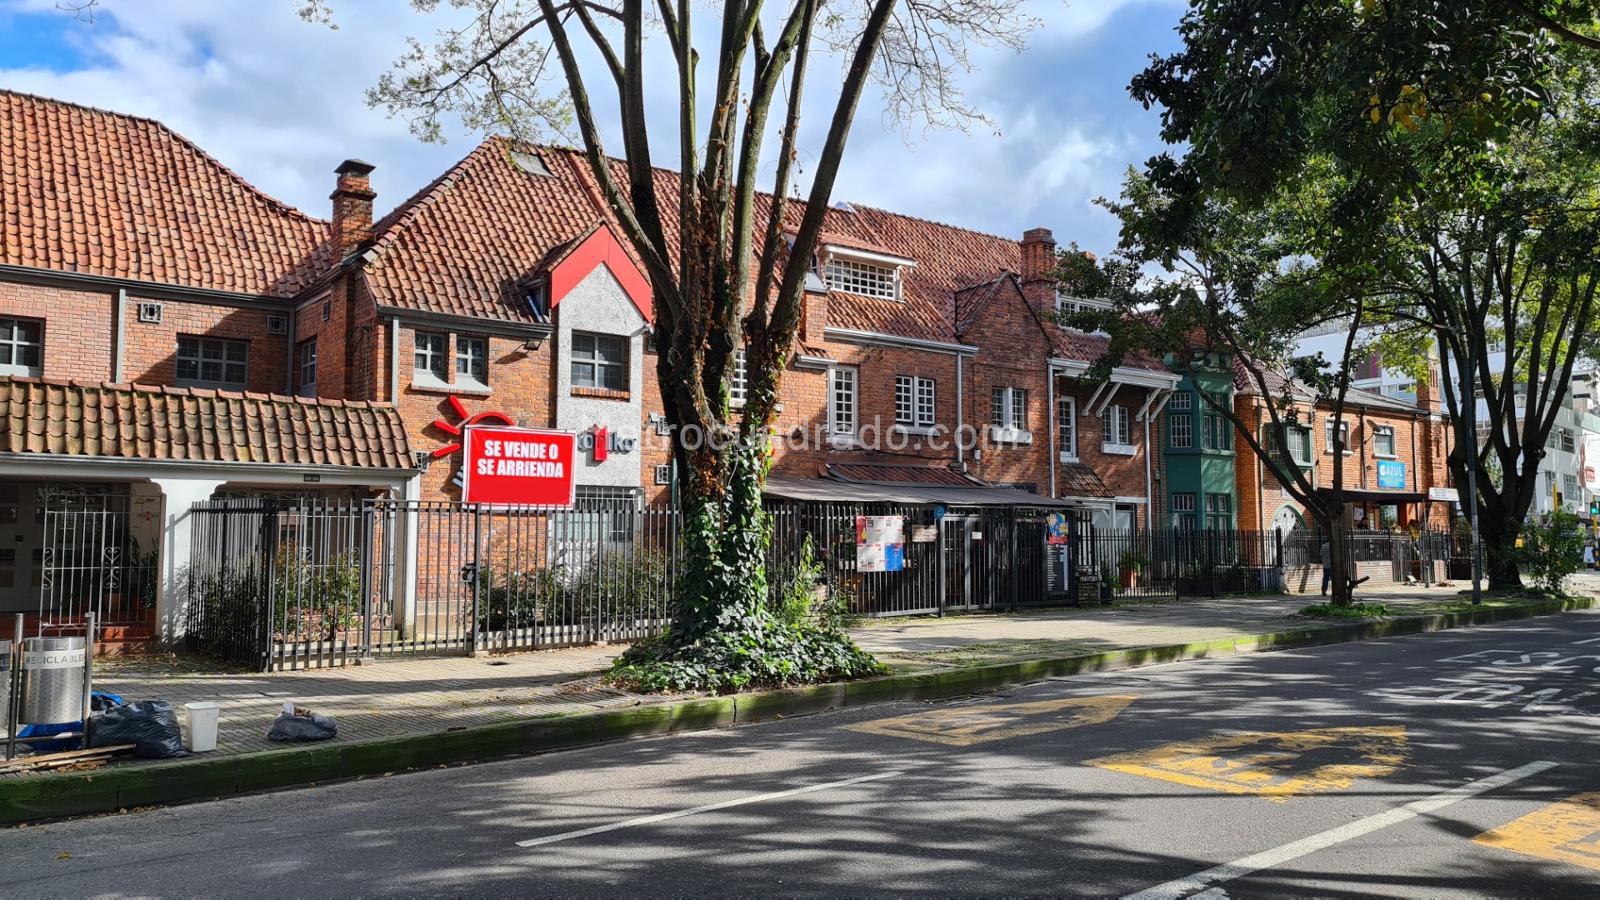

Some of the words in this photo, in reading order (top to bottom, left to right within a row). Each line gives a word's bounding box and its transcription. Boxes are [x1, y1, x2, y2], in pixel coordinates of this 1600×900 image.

[484, 440, 502, 457] SE
[503, 441, 547, 459] VENDE
[549, 443, 559, 460] O
[477, 458, 495, 475] SE
[496, 460, 564, 478] ARRIENDA
